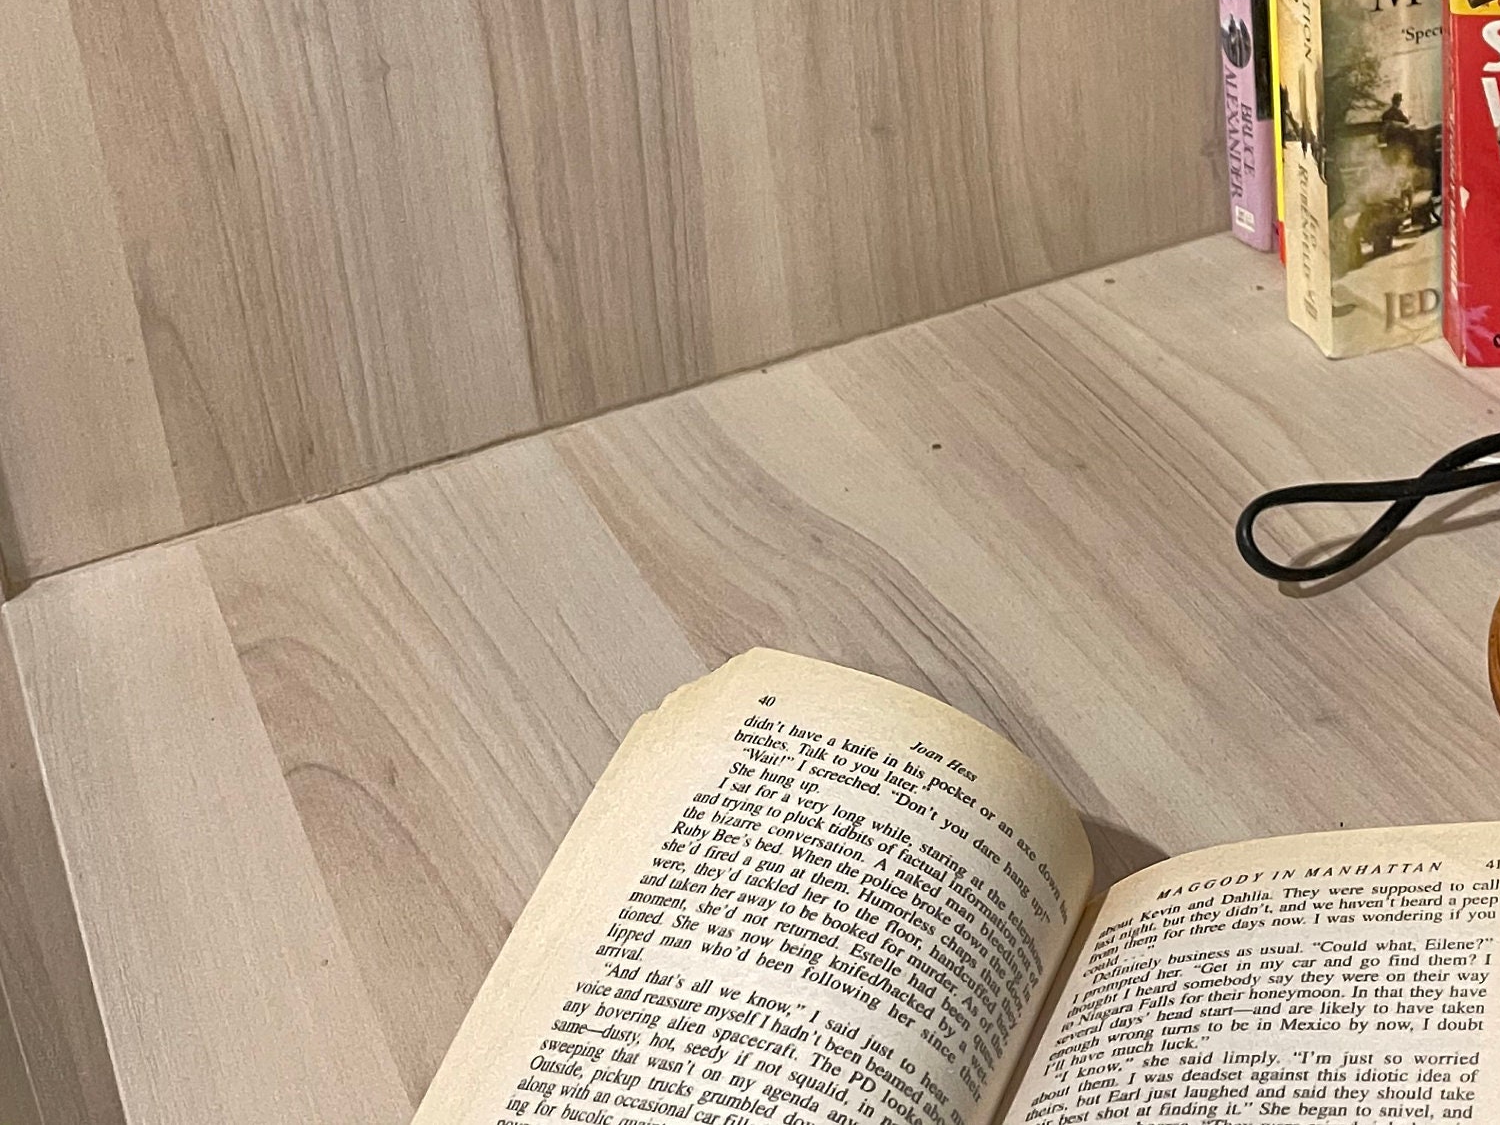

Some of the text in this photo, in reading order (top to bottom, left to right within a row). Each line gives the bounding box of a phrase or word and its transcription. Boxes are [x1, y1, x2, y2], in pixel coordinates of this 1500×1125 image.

[1224, 65, 1243, 198] ALEXANDER
[1241, 103, 1255, 177] BRUCE
[1384, 286, 1441, 333] JED
[758, 695, 776, 706] 40
[729, 762, 820, 793] She hung up.
[734, 729, 789, 751] britches.
[798, 743, 828, 760] Talk
[833, 753, 847, 765] to
[850, 763, 879, 780] you
[910, 741, 978, 783] Joan Hess
[743, 748, 794, 766] "Wait!"
[797, 760, 807, 771] I
[809, 767, 881, 796] screeched.
[892, 790, 938, 820] "Don't
[940, 818, 969, 840] you
[973, 838, 1001, 864] dare
[1003, 862, 1029, 898] hang
[744, 715, 1060, 901] didn't have a knife in his pocket or an axe down
[693, 792, 720, 805] and
[722, 798, 764, 816] trying
[766, 806, 781, 818] to
[783, 811, 825, 830] pluck
[828, 824, 874, 847] tidbits
[878, 841, 896, 854] of
[898, 849, 948, 883] factual
[718, 778, 1006, 910] I sat for a very long while, staring at the
[1156, 861, 1442, 901] MAGGODY IN MANHATTAN
[1485, 859, 1500, 870] 41
[662, 839, 977, 969] she'd fired a gun at them. Humorless chaps
[1099, 879, 1500, 939] about Kevin and Dahlia. They were supposed to call
[596, 944, 643, 961] arrival.
[1092, 956, 1162, 984] Definitely
[1168, 948, 1230, 965] business
[1237, 948, 1252, 956] as
[1260, 943, 1303, 955] usual.
[1312, 940, 1367, 952] "Could
[1425, 938, 1494, 950] Eilene?"
[1072, 954, 1492, 1004] I prompted her. "Get in my car and go find them? I
[604, 962, 949, 1105] "And that's all we know," I said just to hear
[607, 923, 982, 1103] lipped man who'd been following her since their
[1043, 1036, 1209, 1076] I'll have much luck."
[1049, 1017, 1483, 1061] enough wrong turns to be in Mexico by now, I doubt
[530, 1055, 778, 1122] Outside, pickup trucks grumbled
